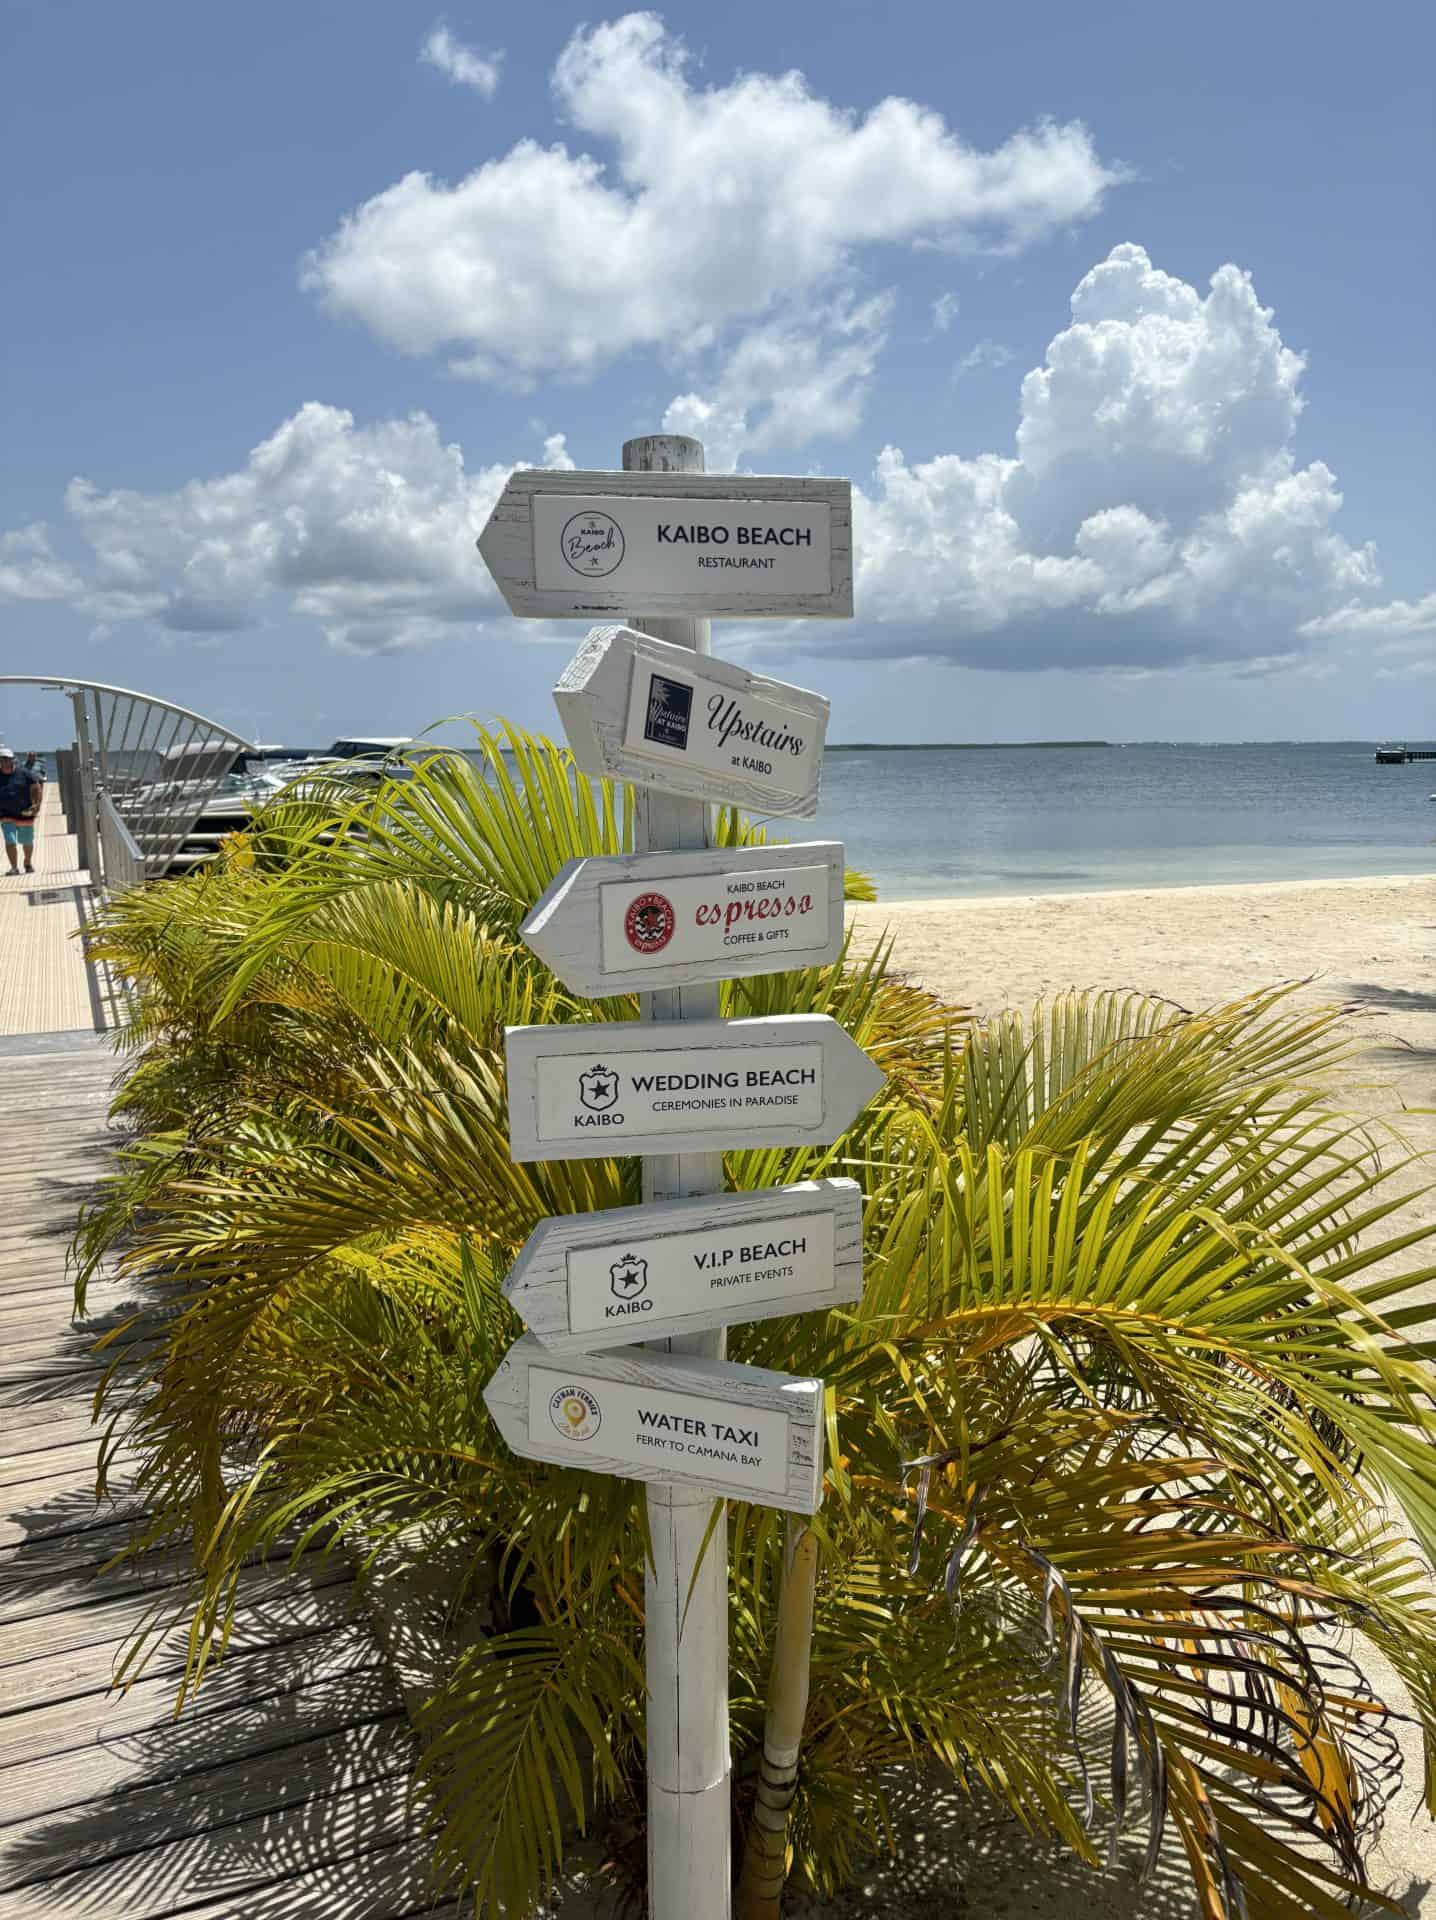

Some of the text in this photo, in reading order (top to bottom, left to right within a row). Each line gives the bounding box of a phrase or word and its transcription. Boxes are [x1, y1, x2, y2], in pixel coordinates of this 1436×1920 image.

[568, 526, 616, 560] Beach
[657, 524, 812, 547] KAIBO BEACH
[698, 557, 776, 569] RESTAURANT
[707, 694, 805, 756] Upstairs
[731, 755, 773, 775] at KAIBO
[727, 880, 786, 894] KAIBO BEACH
[695, 893, 815, 934] espresso
[723, 929, 789, 945] COFFEE & GIFTS
[632, 1068, 816, 1092] WEDDING BEACH
[652, 1094, 800, 1112] CEREMONIES IN PARADISE
[574, 1113, 625, 1127] KAIBO
[694, 1238, 807, 1270] V.I.P BEACH
[710, 1266, 794, 1289] PRIVATE EVENTS
[605, 1300, 654, 1318] KAIBO
[638, 1410, 760, 1447] WATER TAXI
[636, 1434, 763, 1467] FERRY TO CAMANA BAY
